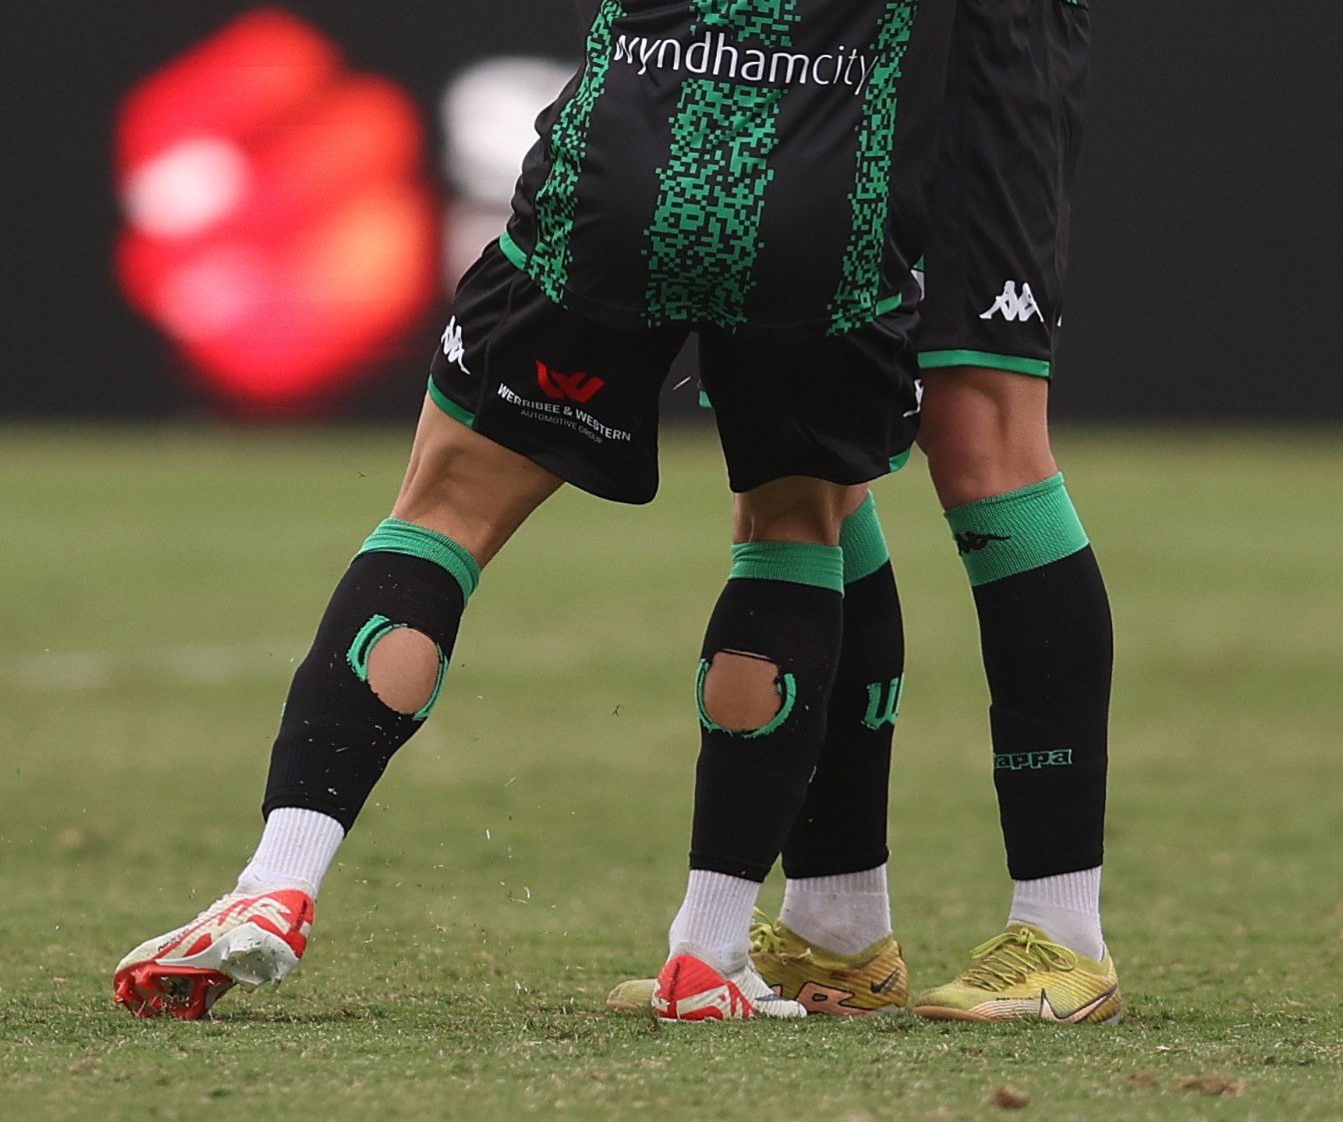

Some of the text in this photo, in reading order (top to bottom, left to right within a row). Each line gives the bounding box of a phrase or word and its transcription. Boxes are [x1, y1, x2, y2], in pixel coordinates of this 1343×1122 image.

[613, 31, 879, 95] wyndhamcity
[497, 382, 631, 442] WERRIBEE & WESTERN
[520, 409, 603, 444] AUTOMOTIVE GROUP
[994, 748, 1072, 770] appa
